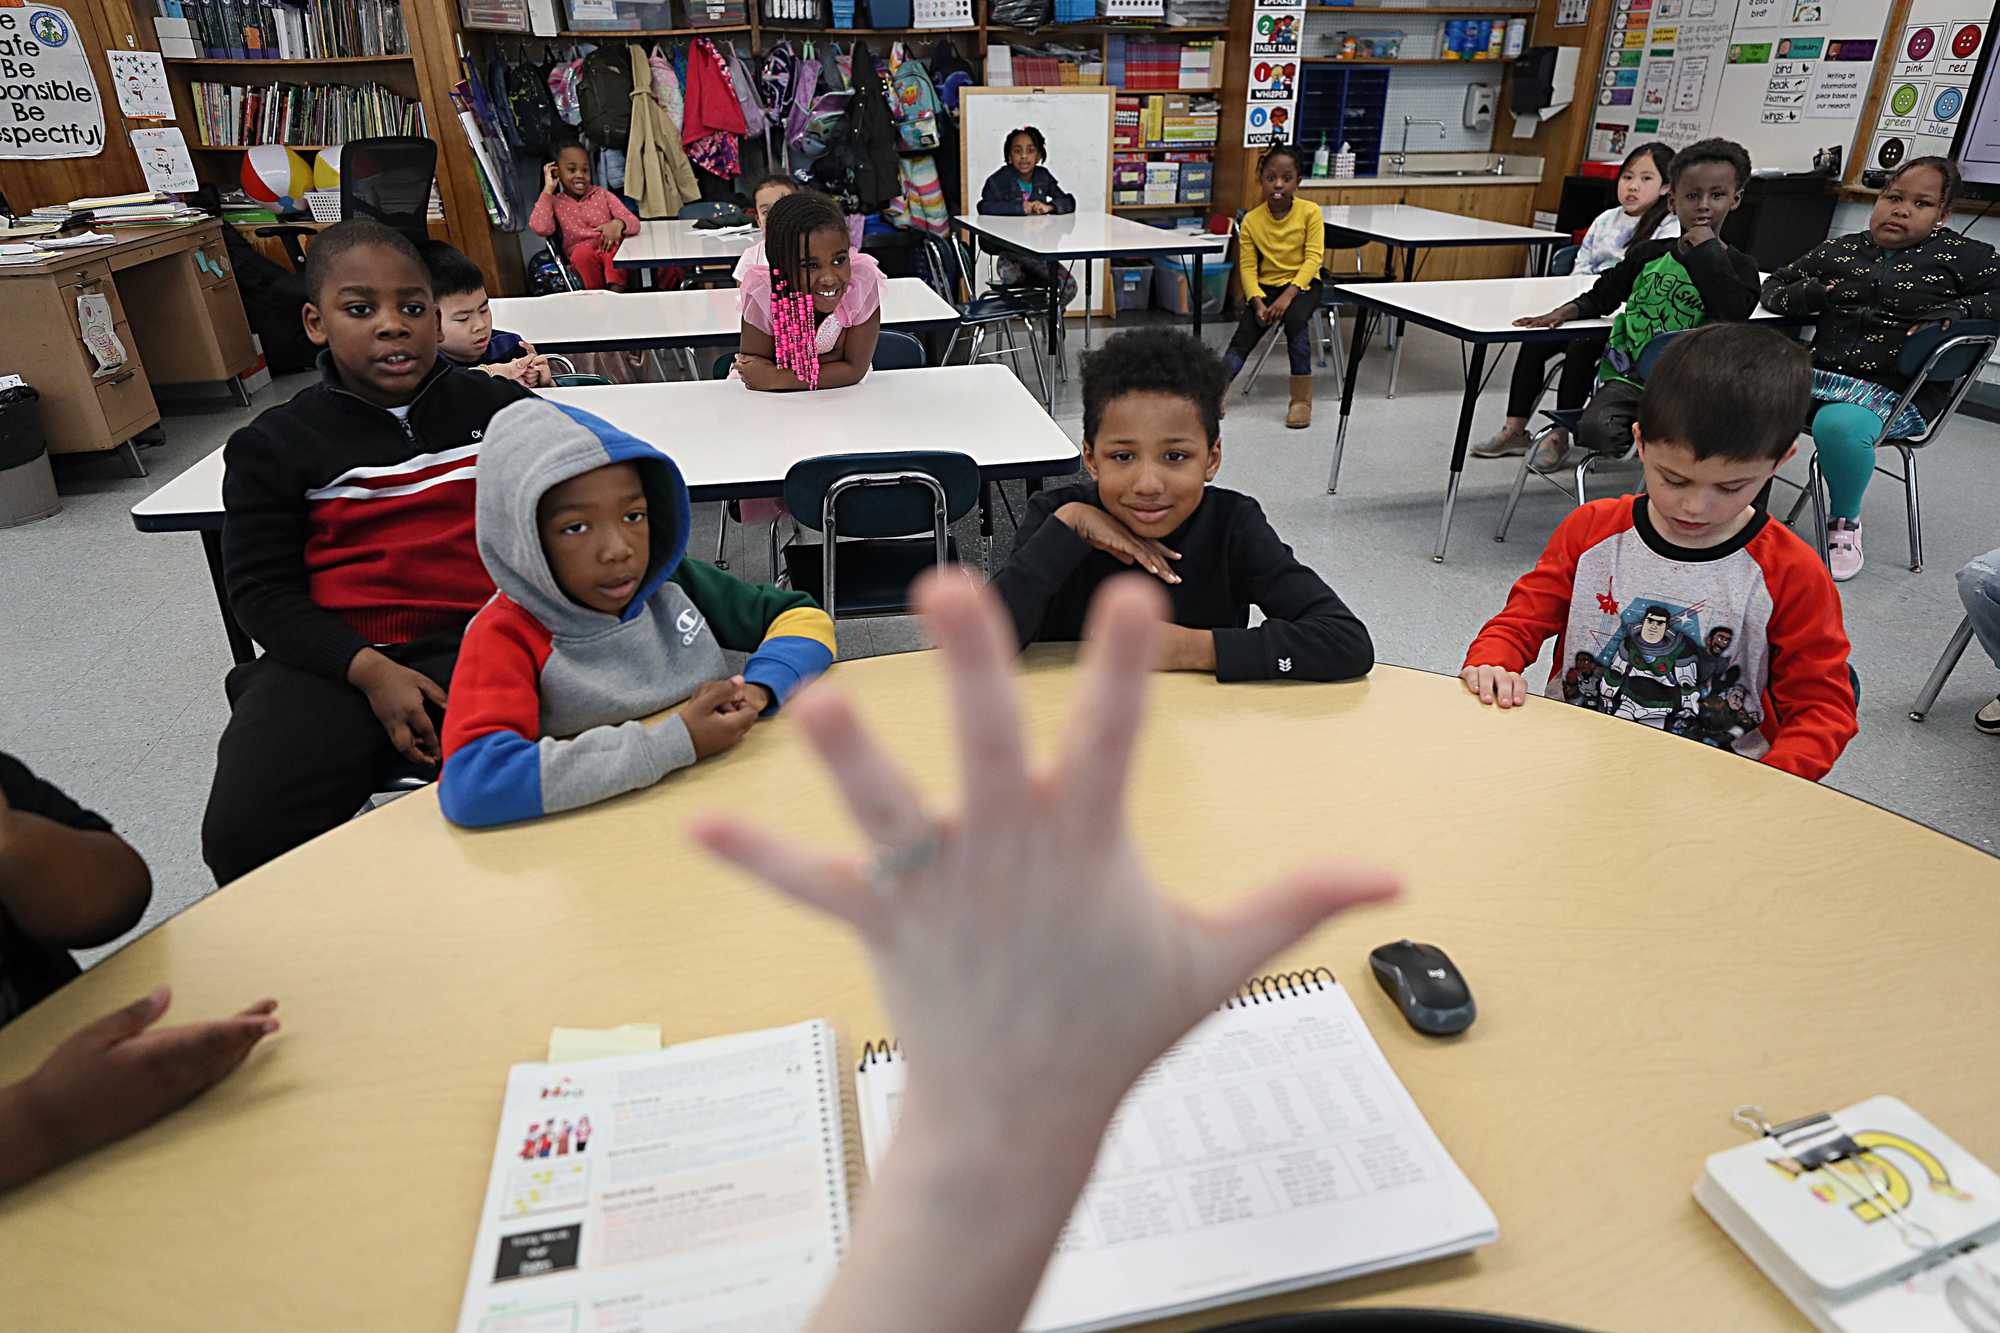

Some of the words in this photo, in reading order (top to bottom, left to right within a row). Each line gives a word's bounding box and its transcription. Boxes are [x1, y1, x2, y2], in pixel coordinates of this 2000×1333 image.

[1262, 21, 1270, 34] 2
[0, 34, 40, 57] afe
[1255, 44, 1276, 52] TABLE
[1278, 44, 1297, 52] TALK
[1, 59, 36, 79] Be
[1775, 63, 1793, 74] bird
[1905, 63, 1923, 75] pink
[1948, 61, 1968, 73] red
[1260, 68, 1265, 81] 1
[1769, 77, 1789, 90] beak
[1255, 90, 1288, 98] WHISPER
[11, 102, 45, 122] Be
[1764, 112, 1784, 123] wings
[1254, 113, 1263, 126] 0
[1884, 117, 1912, 129] green
[1928, 123, 1949, 135] blue
[0, 123, 102, 149] spectful
[1249, 134, 1272, 143] VOICE
